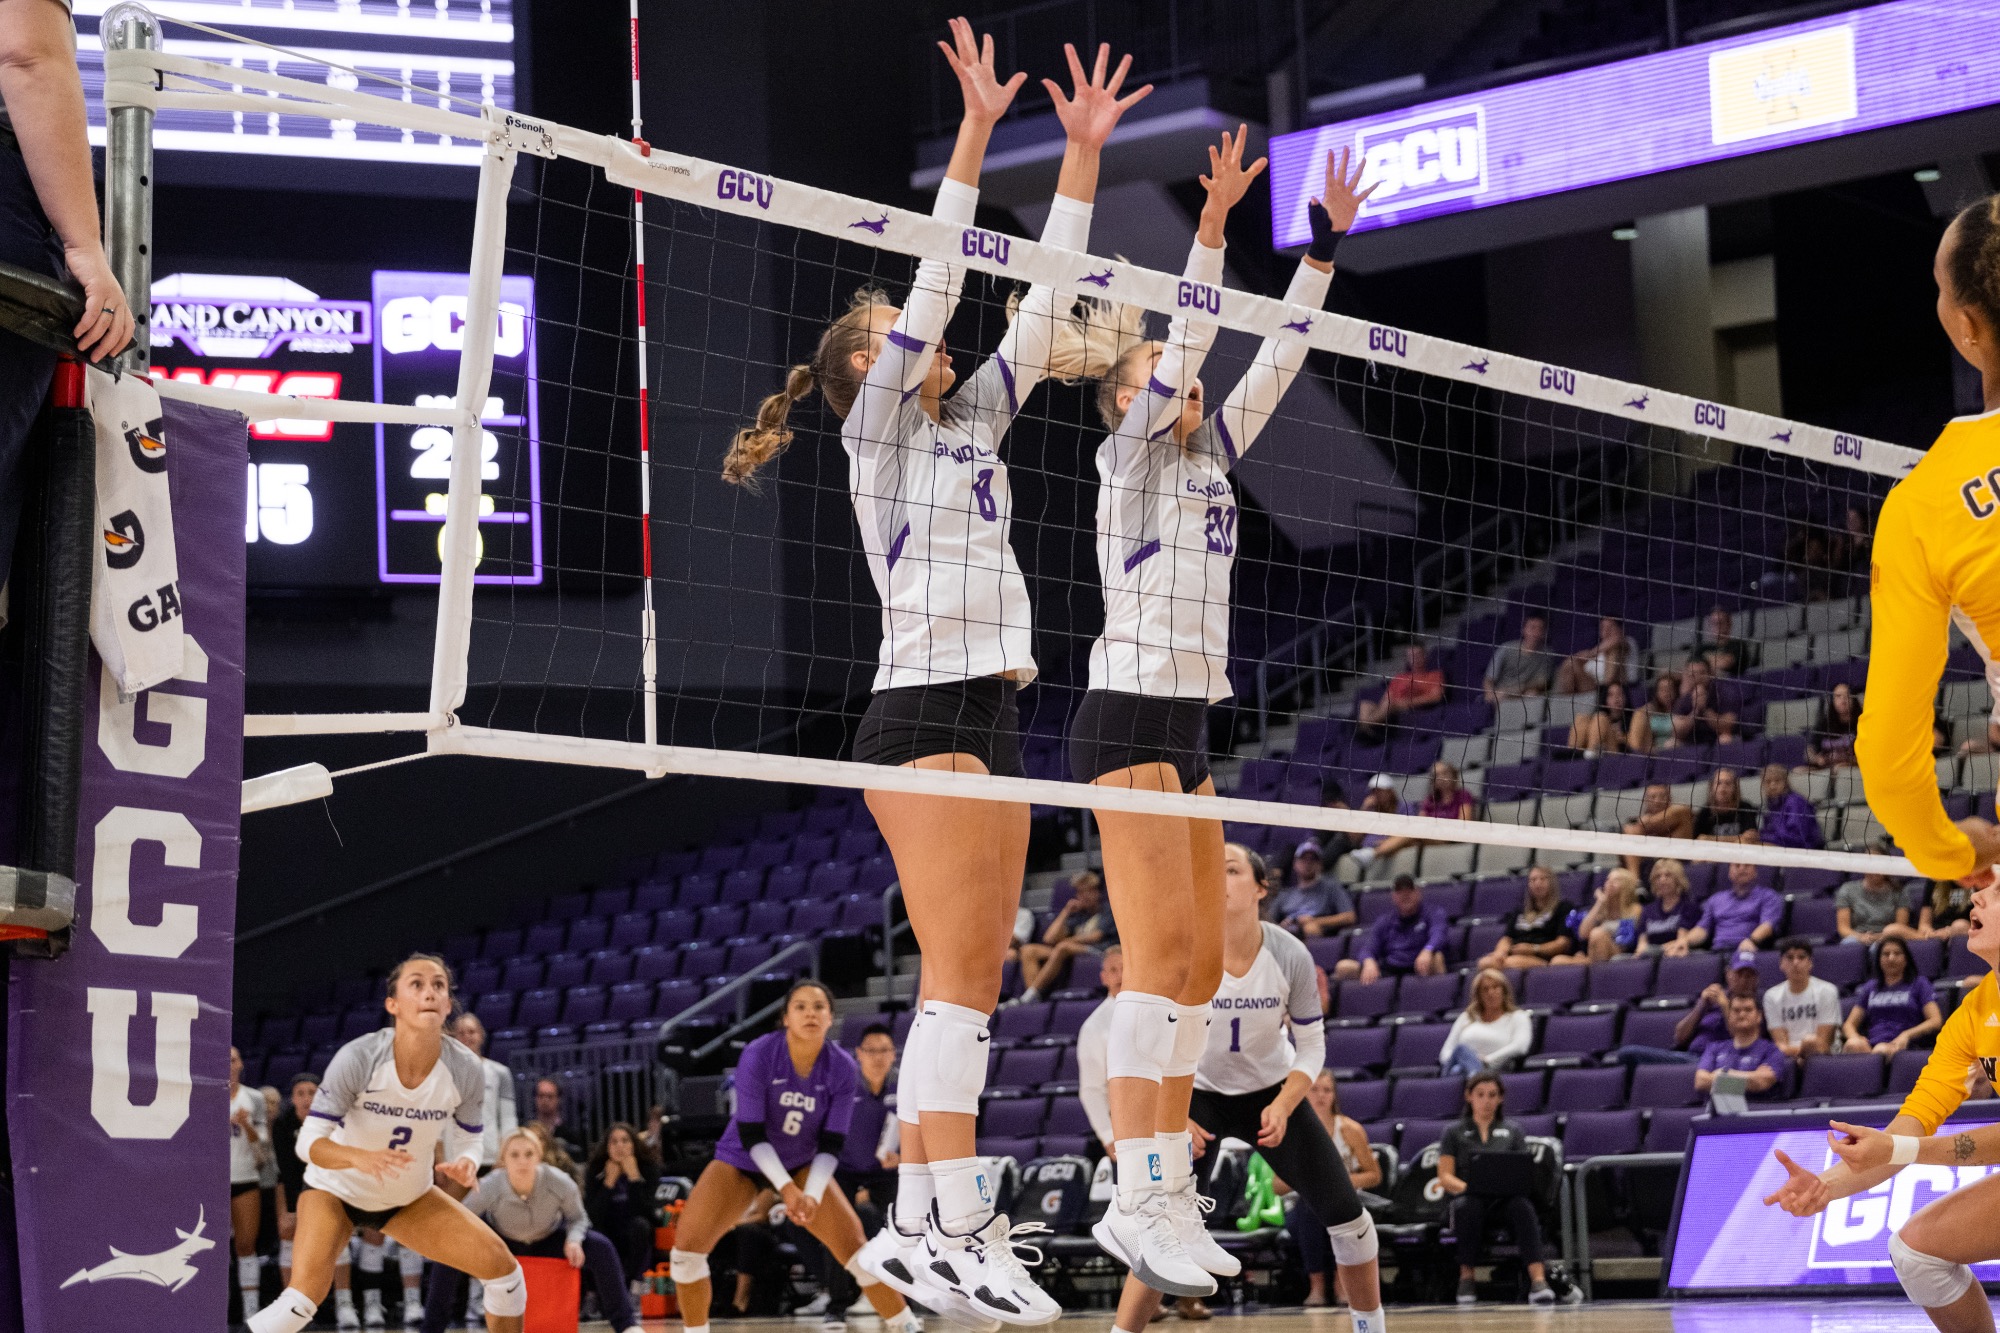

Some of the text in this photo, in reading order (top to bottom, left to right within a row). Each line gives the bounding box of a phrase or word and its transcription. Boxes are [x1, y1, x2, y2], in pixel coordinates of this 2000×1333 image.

[514, 119, 545, 135] Senoh
[717, 169, 774, 210] GCU
[962, 229, 1011, 266] GCU
[1178, 281, 1221, 316] GCU
[150, 302, 354, 335] AND CANYON
[1369, 327, 1407, 358] GCU
[1540, 366, 1575, 395] GCU
[1694, 403, 1726, 430] GCU
[1833, 434, 1863, 460] GCU
[972, 468, 997, 522] 8
[1204, 505, 1236, 557] 20
[127, 580, 182, 633] GA
[1235, 997, 1280, 1009] CANYON
[1229, 1017, 1240, 1052] 1
[363, 1101, 447, 1120] GRAND CANYON
[779, 1091, 816, 1113] GCU
[782, 1110, 804, 1136] 6
[1822, 1163, 2000, 1247] GC
